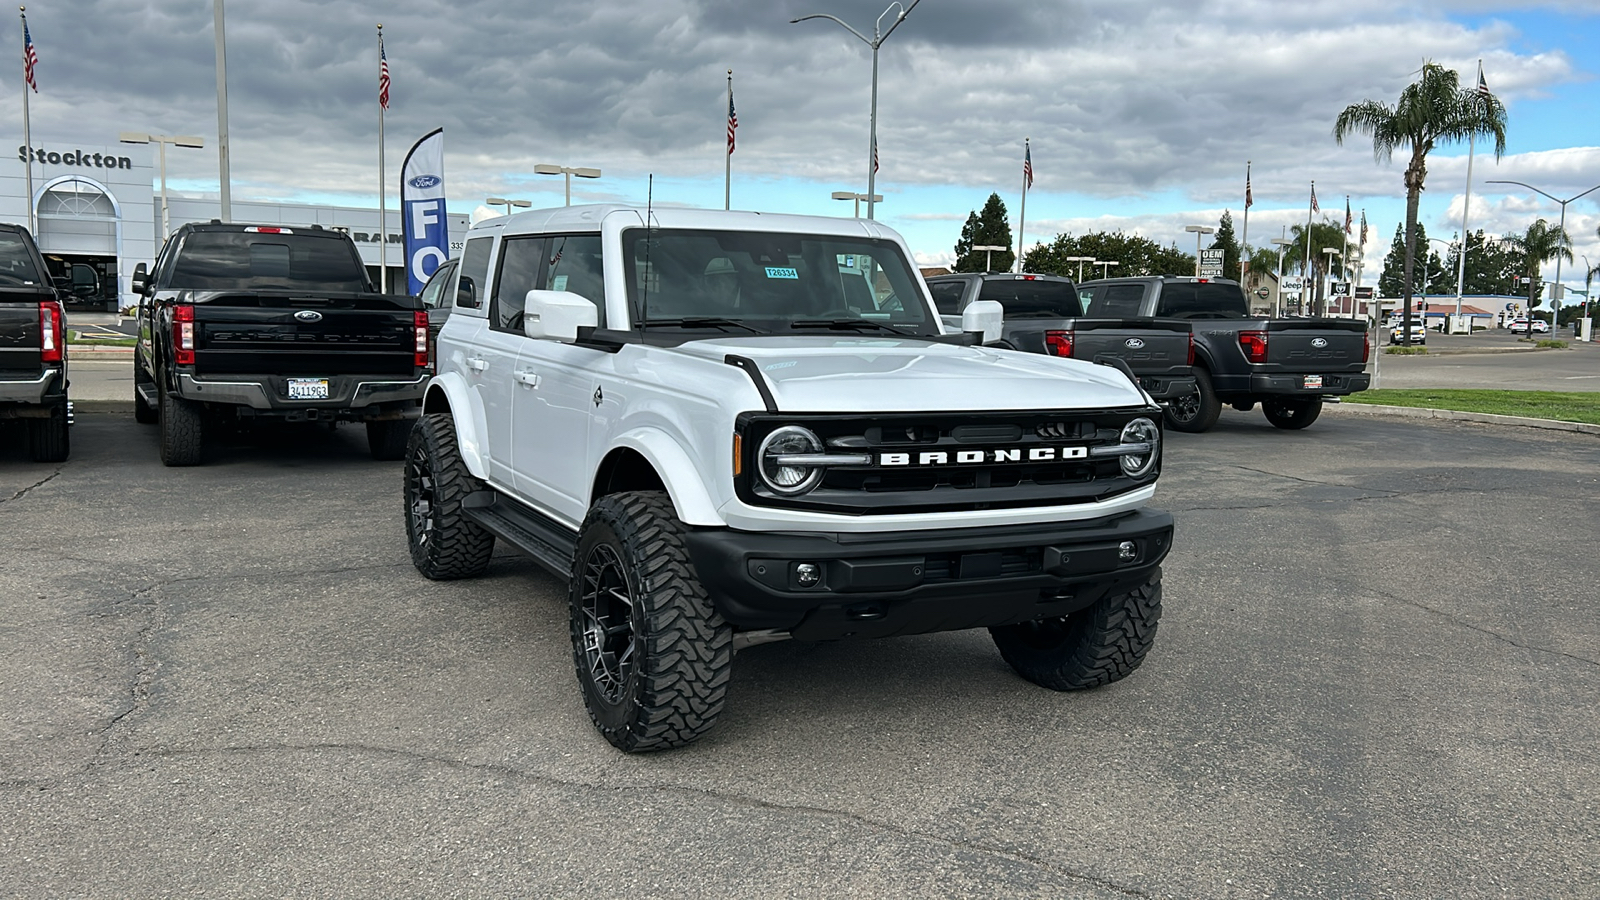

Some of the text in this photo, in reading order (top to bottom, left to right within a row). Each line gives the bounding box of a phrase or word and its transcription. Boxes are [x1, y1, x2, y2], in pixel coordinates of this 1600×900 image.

[18, 145, 132, 170] Stockton
[415, 177, 435, 187] Ford
[411, 201, 446, 297] FO
[766, 268, 796, 277] T26334
[1282, 282, 1302, 290] Jeep
[290, 386, 327, 396] 34119G3
[879, 446, 1089, 466] BRONCO
